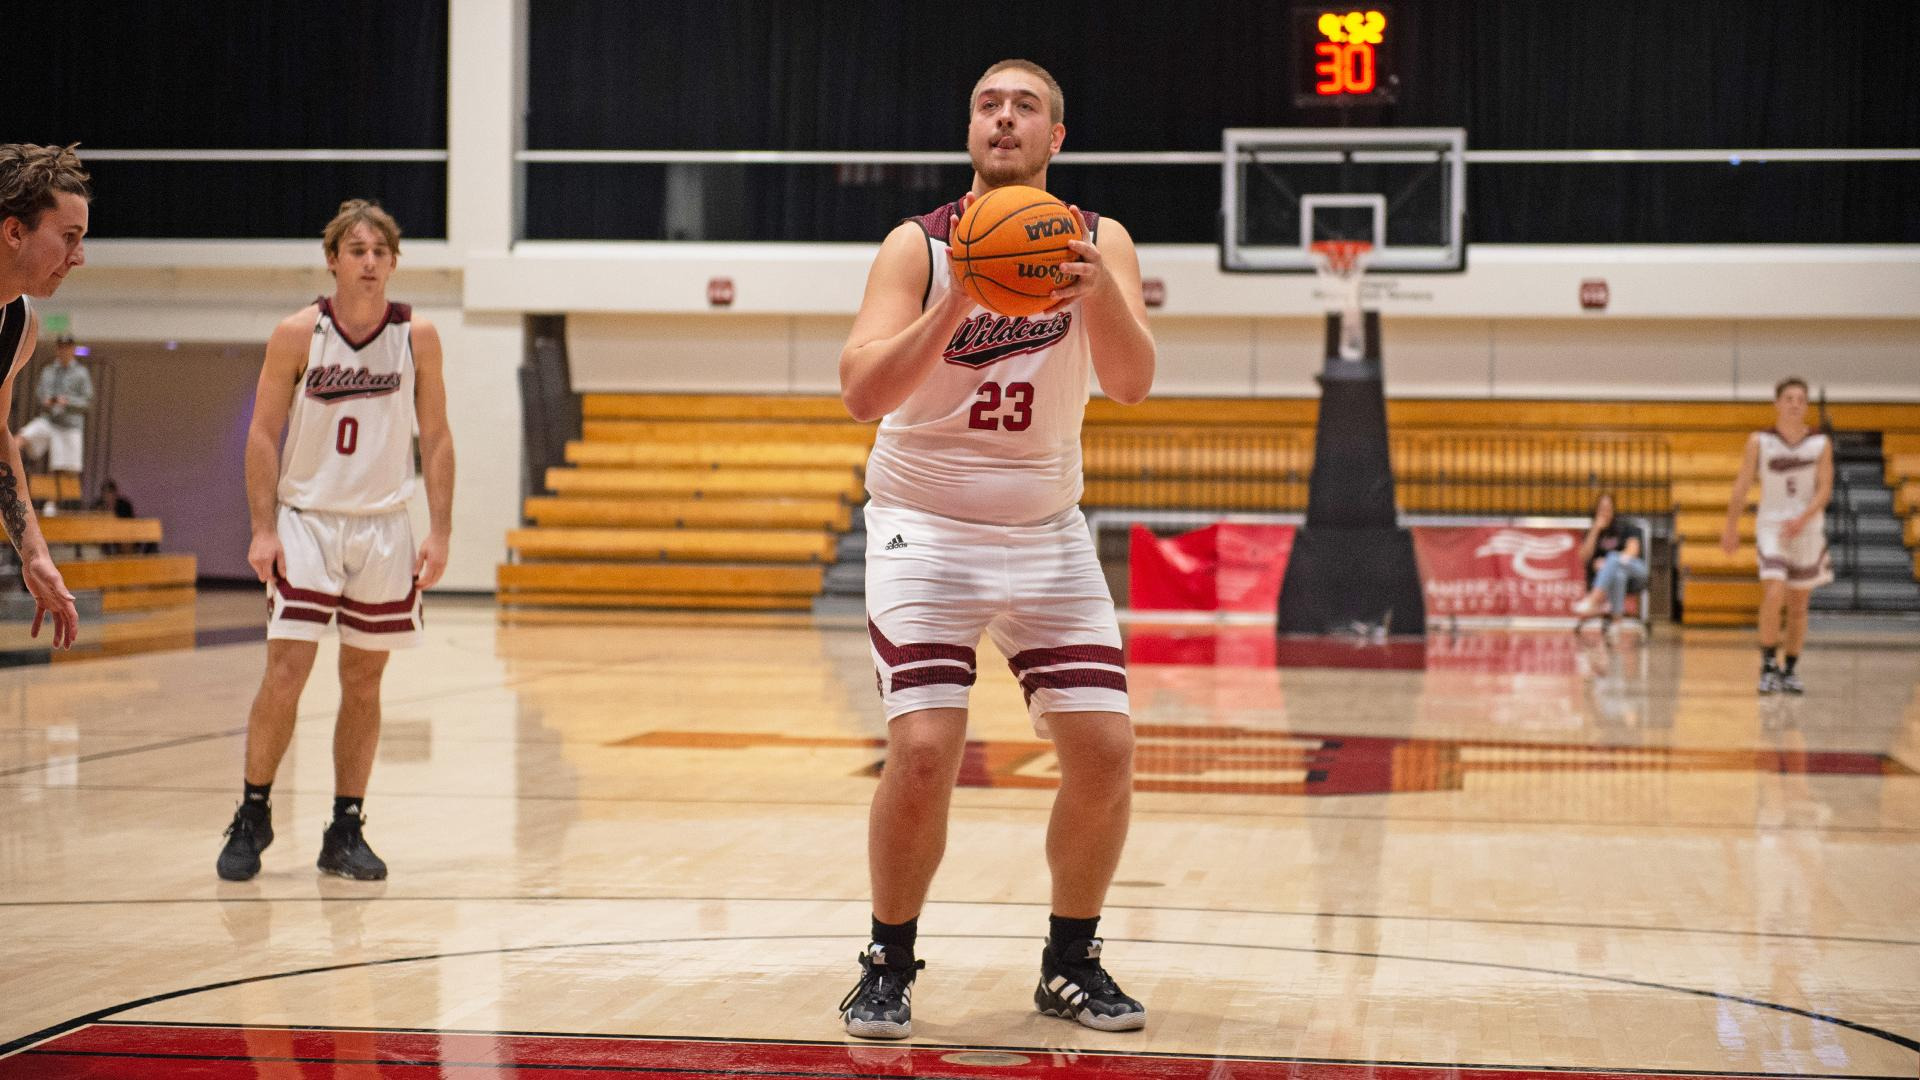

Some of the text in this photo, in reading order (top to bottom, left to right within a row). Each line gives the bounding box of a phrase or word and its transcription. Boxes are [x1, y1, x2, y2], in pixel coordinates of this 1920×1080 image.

[1315, 42, 1376, 95] 30
[1024, 217, 1076, 241] NCAA
[943, 312, 1072, 355] Wildcats
[968, 381, 1035, 432] 23
[336, 416, 359, 456] 0
